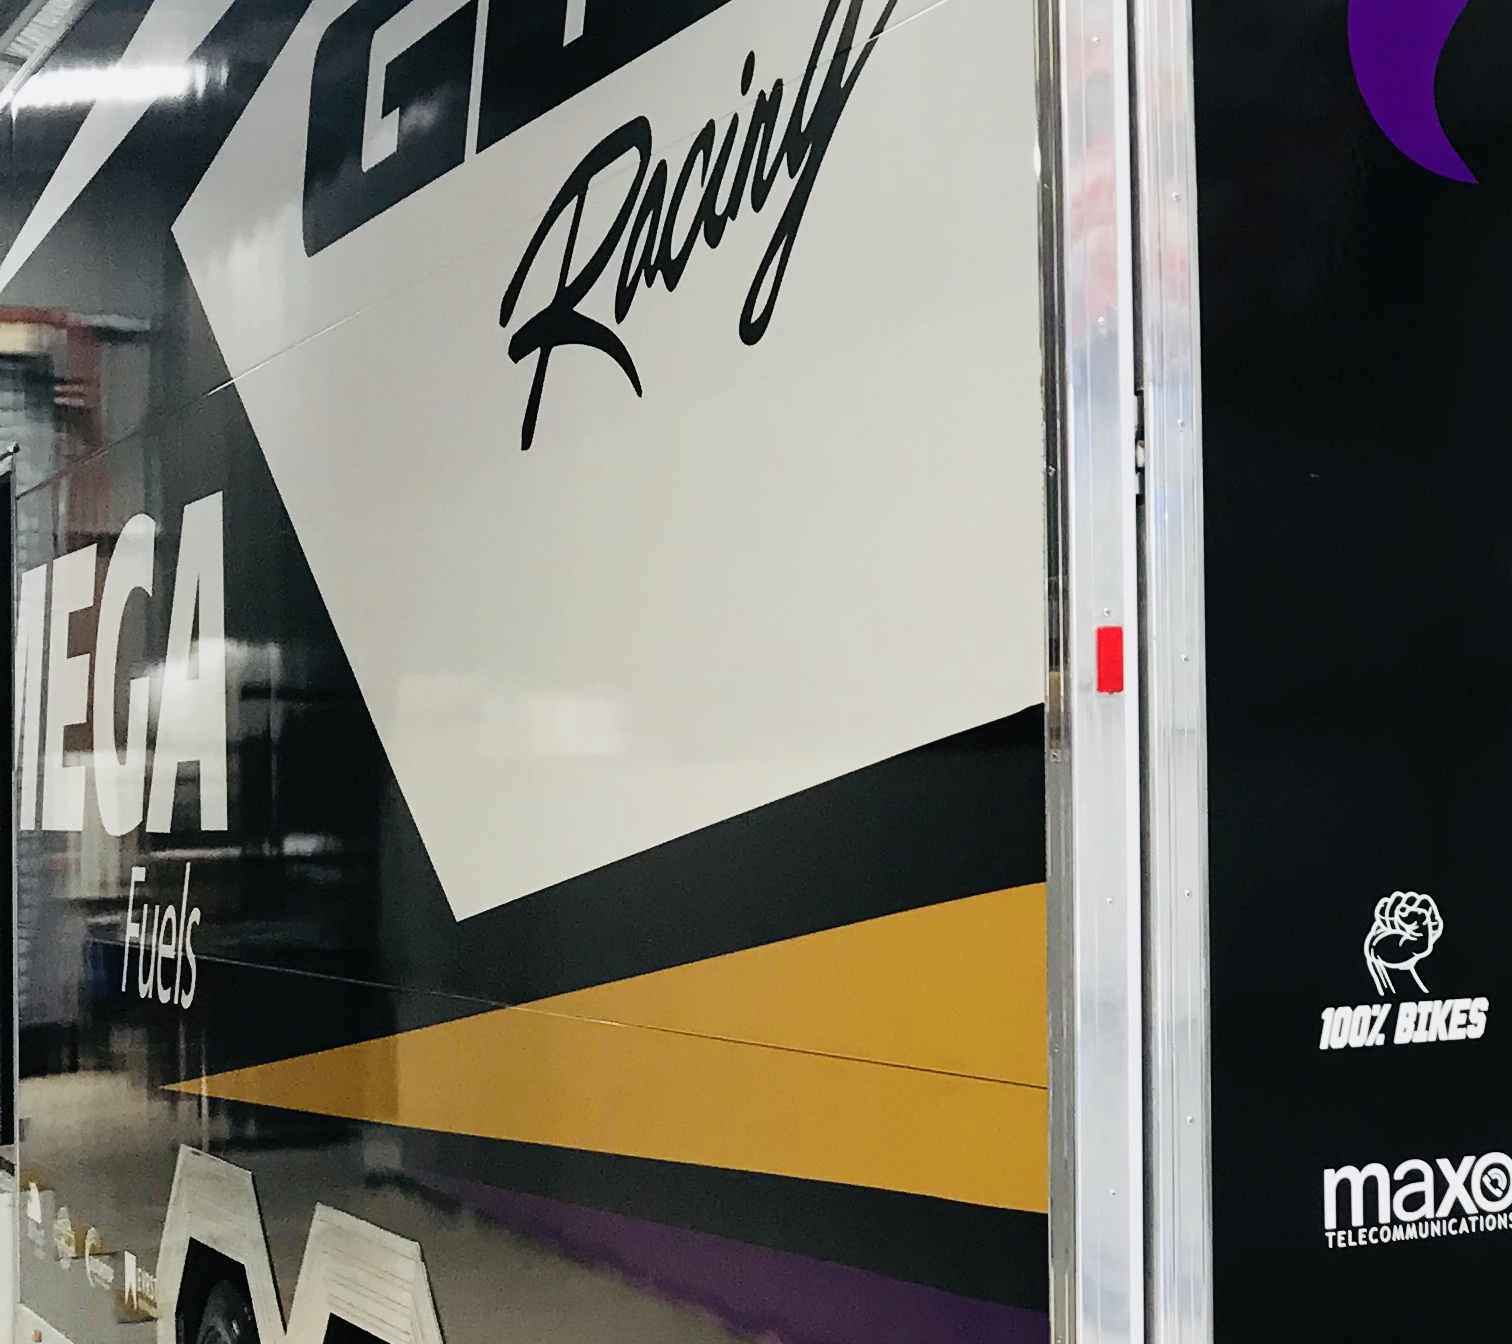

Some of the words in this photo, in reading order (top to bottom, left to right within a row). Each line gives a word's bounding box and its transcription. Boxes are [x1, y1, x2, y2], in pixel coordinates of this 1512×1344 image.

[121, 861, 201, 1010] Fuels
[1319, 1004, 1392, 1049] 100%
[1394, 997, 1489, 1044] BIKES
